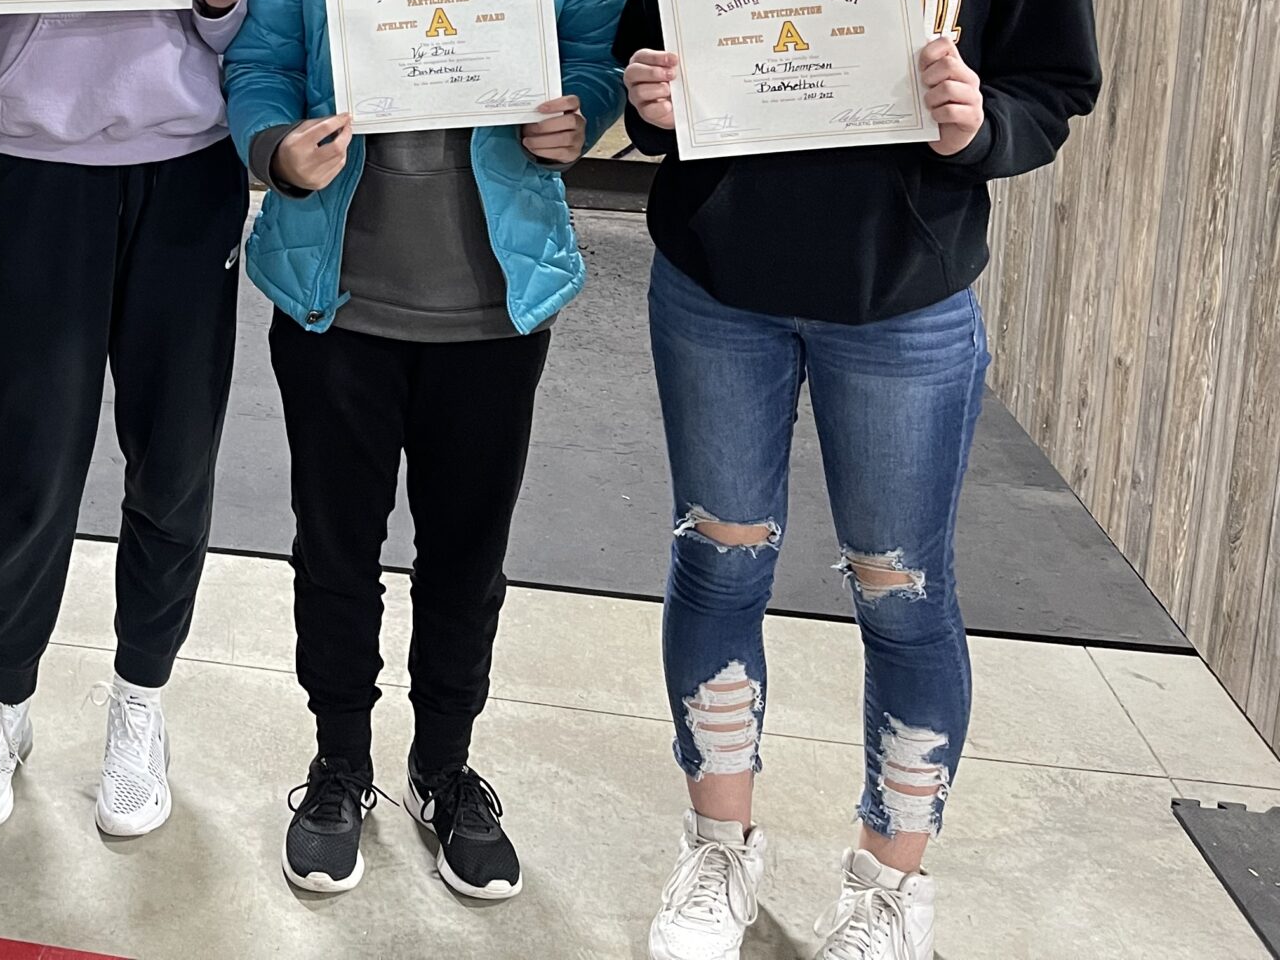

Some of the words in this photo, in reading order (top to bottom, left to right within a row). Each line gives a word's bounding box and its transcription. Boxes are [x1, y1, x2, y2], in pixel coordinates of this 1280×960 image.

[425, 7, 458, 37] A
[751, 5, 822, 20] PARTICIPATION
[376, 20, 418, 32] ATHLETIC
[475, 13, 505, 23] AWARD
[717, 35, 764, 47] ATHLETIC
[830, 25, 865, 37] AWARD
[773, 20, 809, 52] A
[752, 62, 776, 76] Mia
[777, 61, 832, 74] Thompson
[755, 79, 825, 93] Basketball
